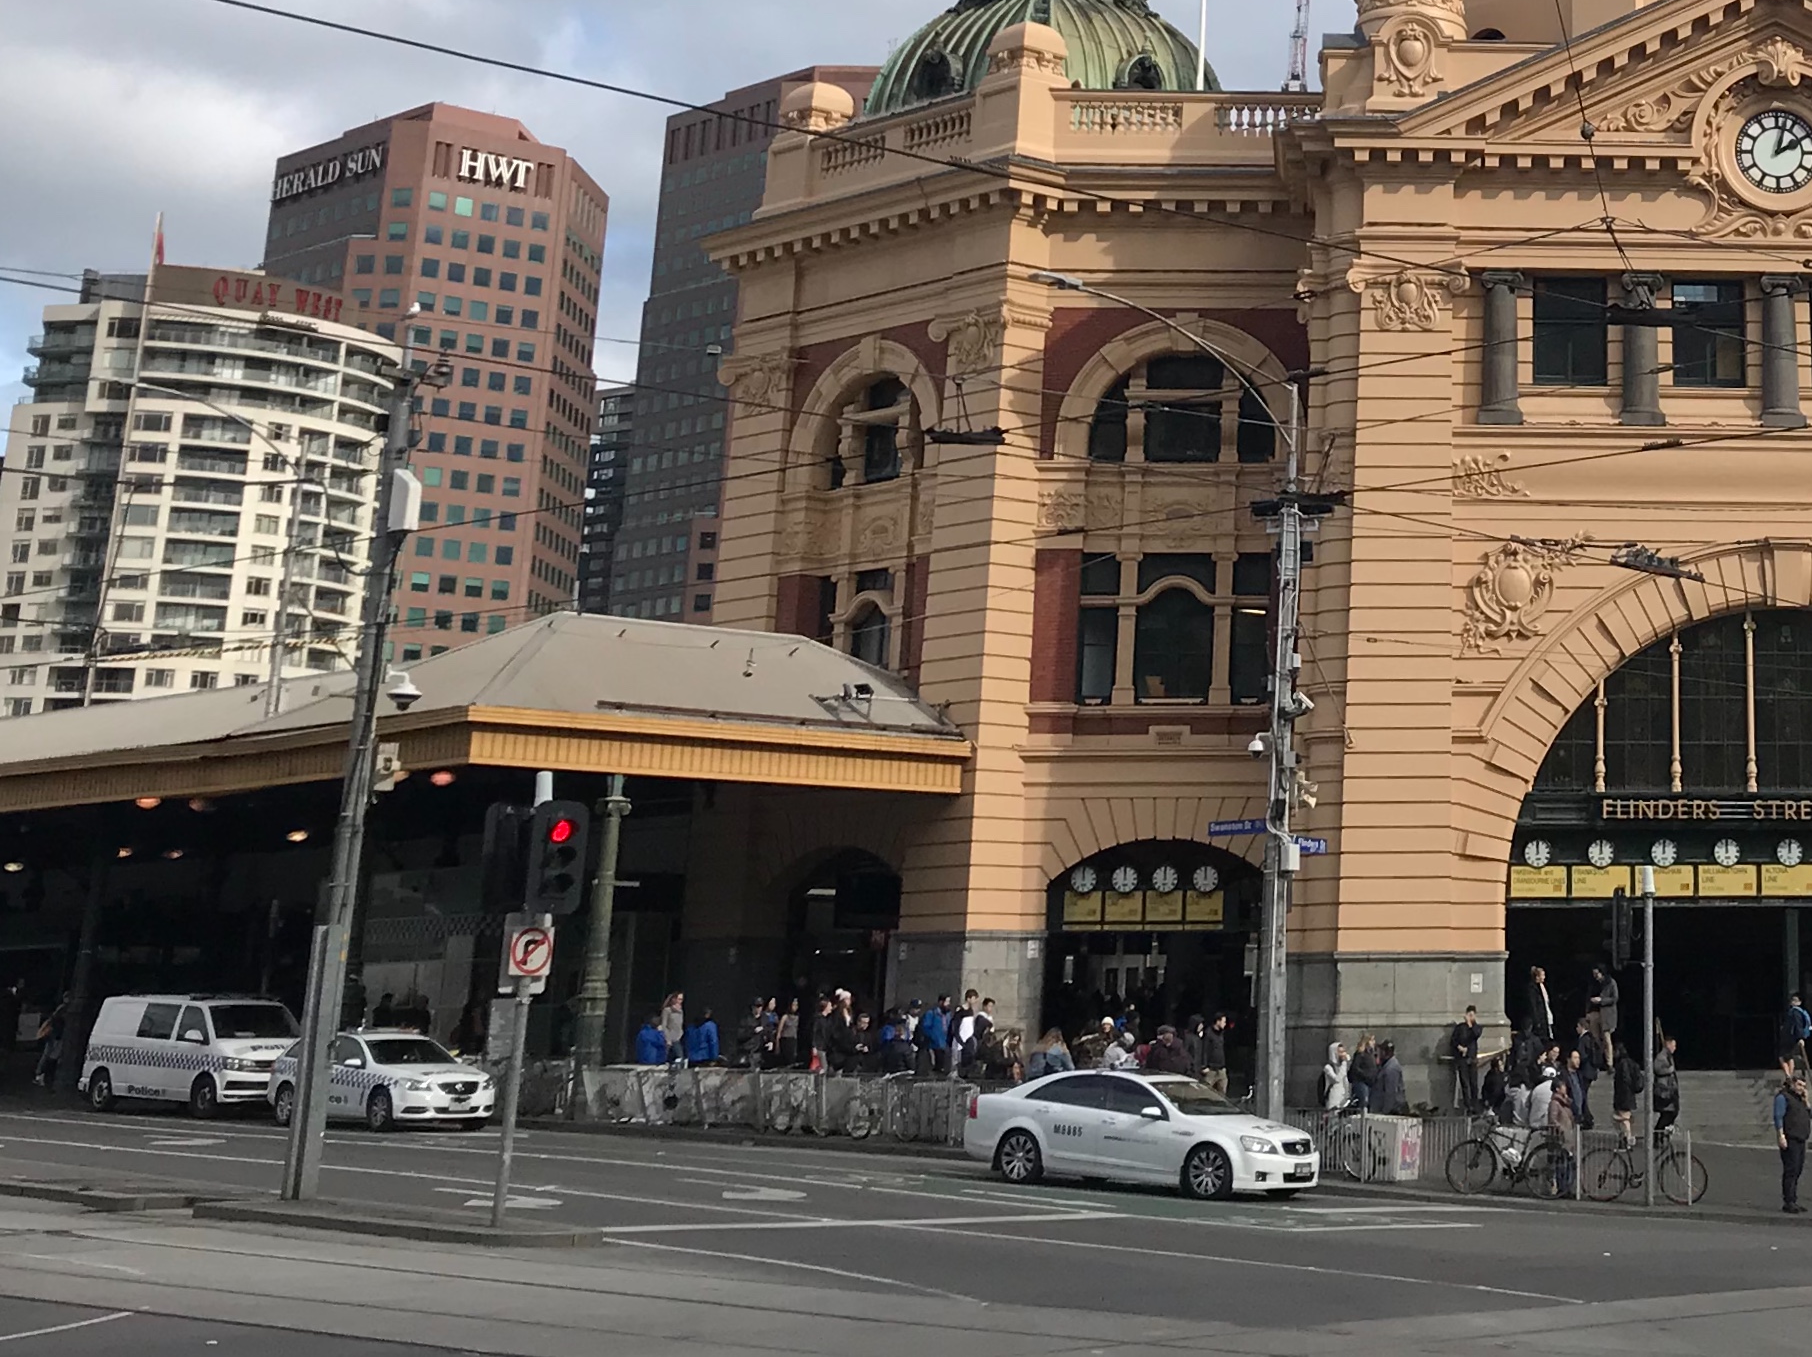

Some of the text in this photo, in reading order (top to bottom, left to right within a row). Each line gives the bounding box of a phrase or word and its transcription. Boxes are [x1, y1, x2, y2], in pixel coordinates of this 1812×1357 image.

[270, 145, 382, 202] HERALD SUN
[459, 148, 534, 188] HWT
[213, 276, 343, 322] QUAY WEST
[1602, 799, 1721, 820] FLINDERS
[128, 1085, 160, 1097] Police
